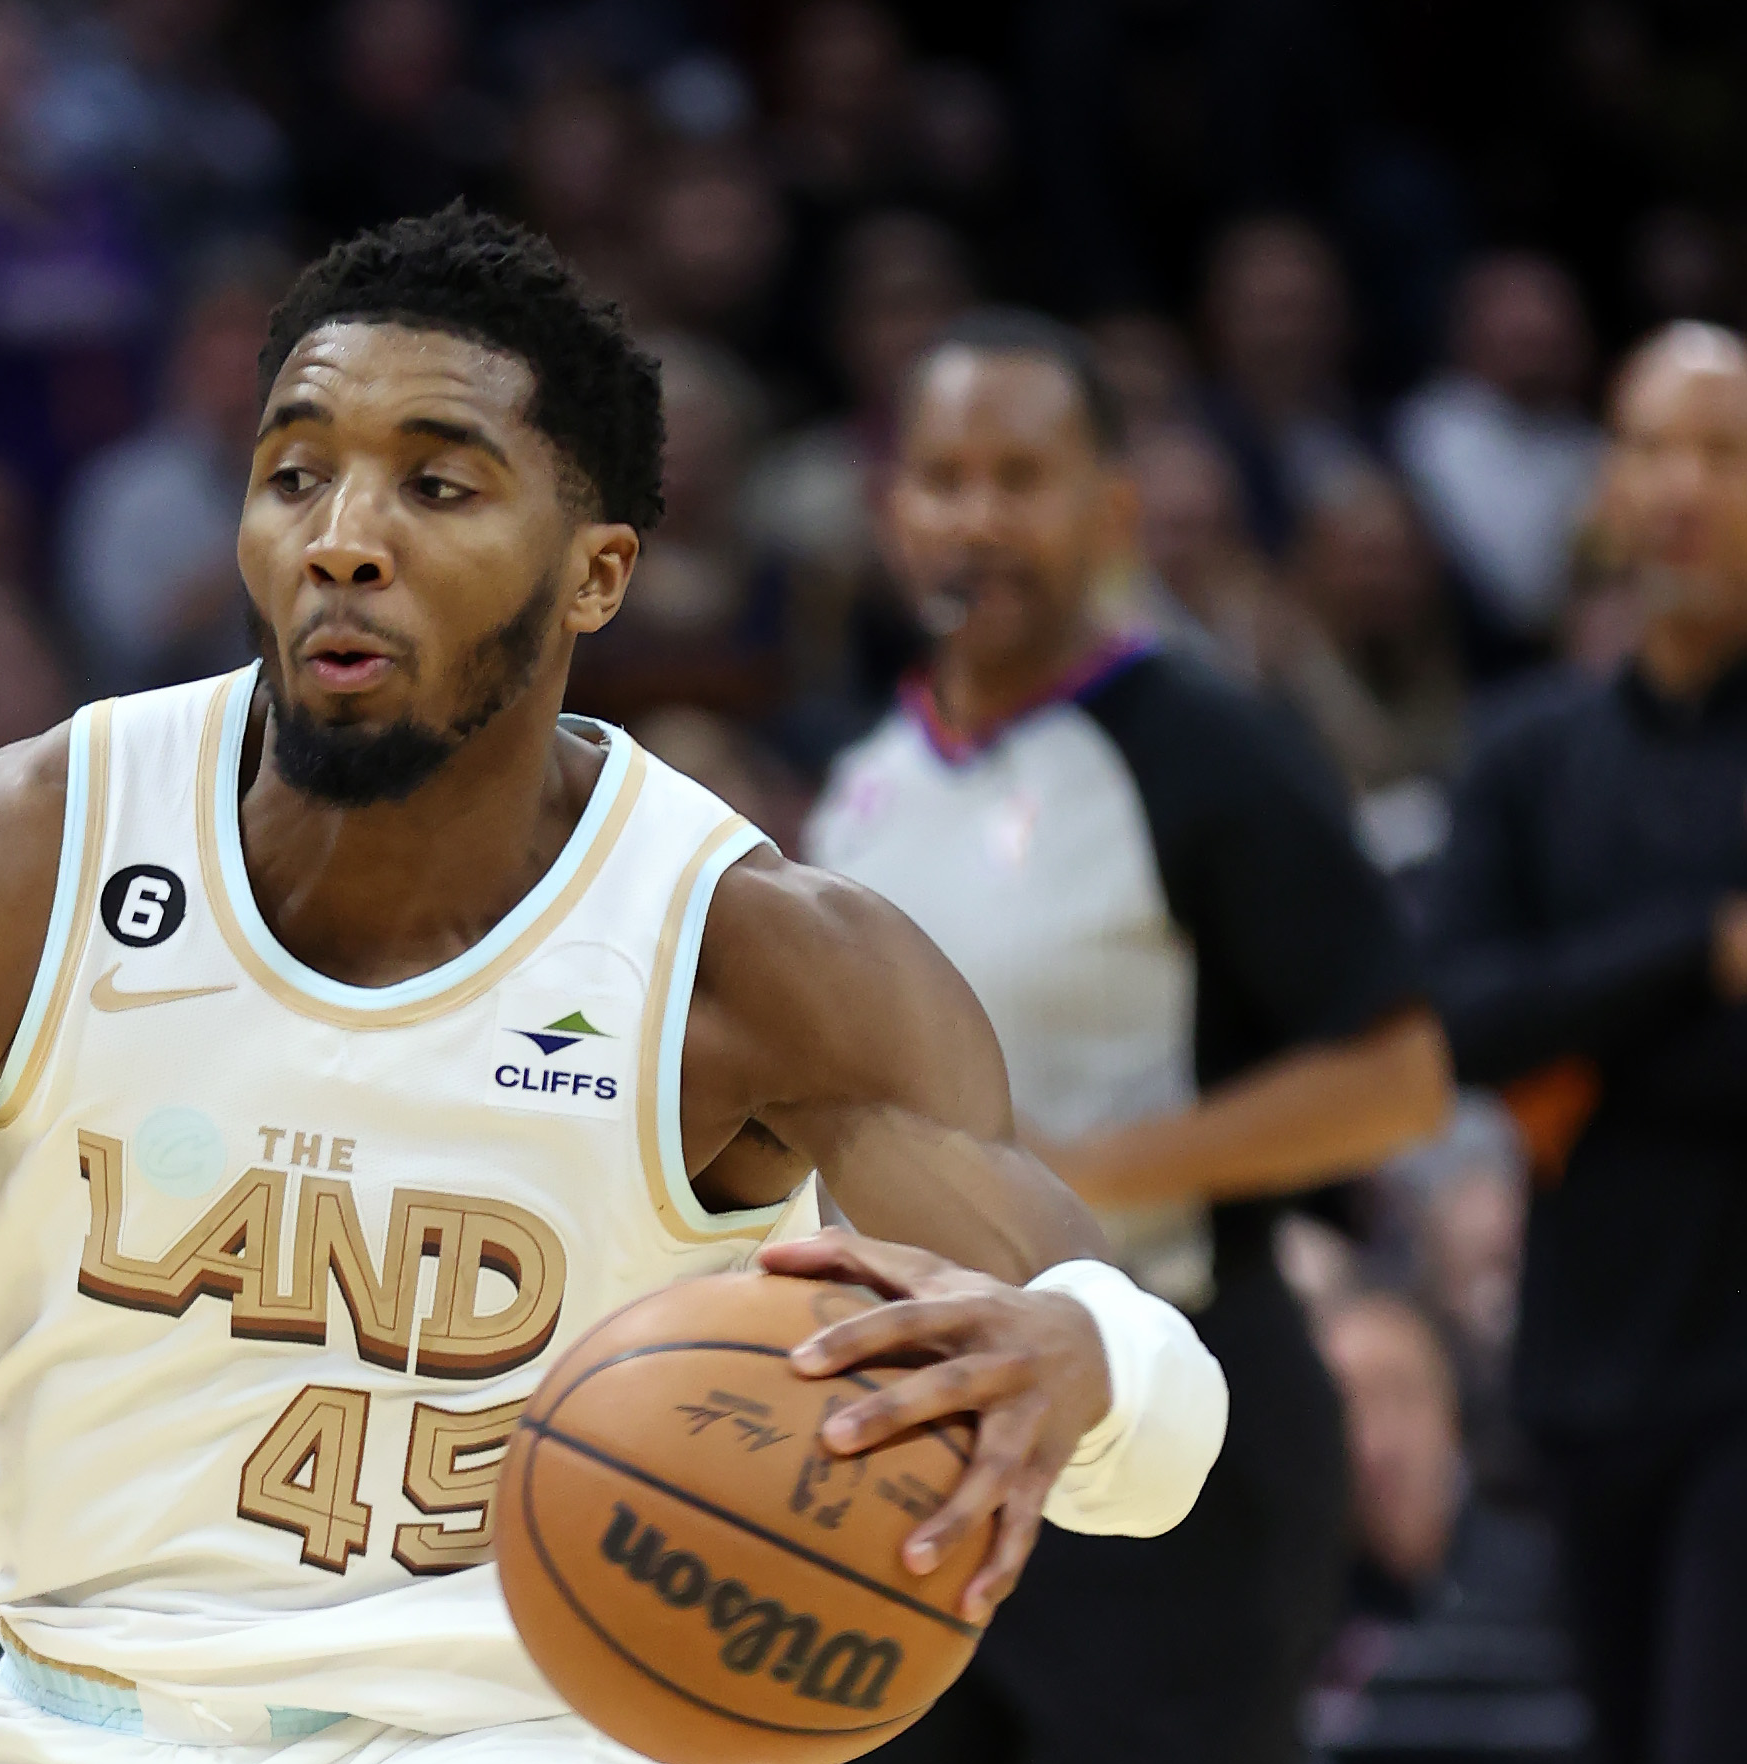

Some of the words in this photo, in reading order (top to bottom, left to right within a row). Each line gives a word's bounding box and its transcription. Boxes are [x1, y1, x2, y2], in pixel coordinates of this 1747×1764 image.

[116, 874, 171, 939] 6
[494, 1064, 618, 1101] CLIFFS
[258, 1125, 357, 1173] THE
[77, 1127, 567, 1378] LAND
[237, 1384, 535, 1576] 45
[598, 1501, 905, 1711] Wilson
